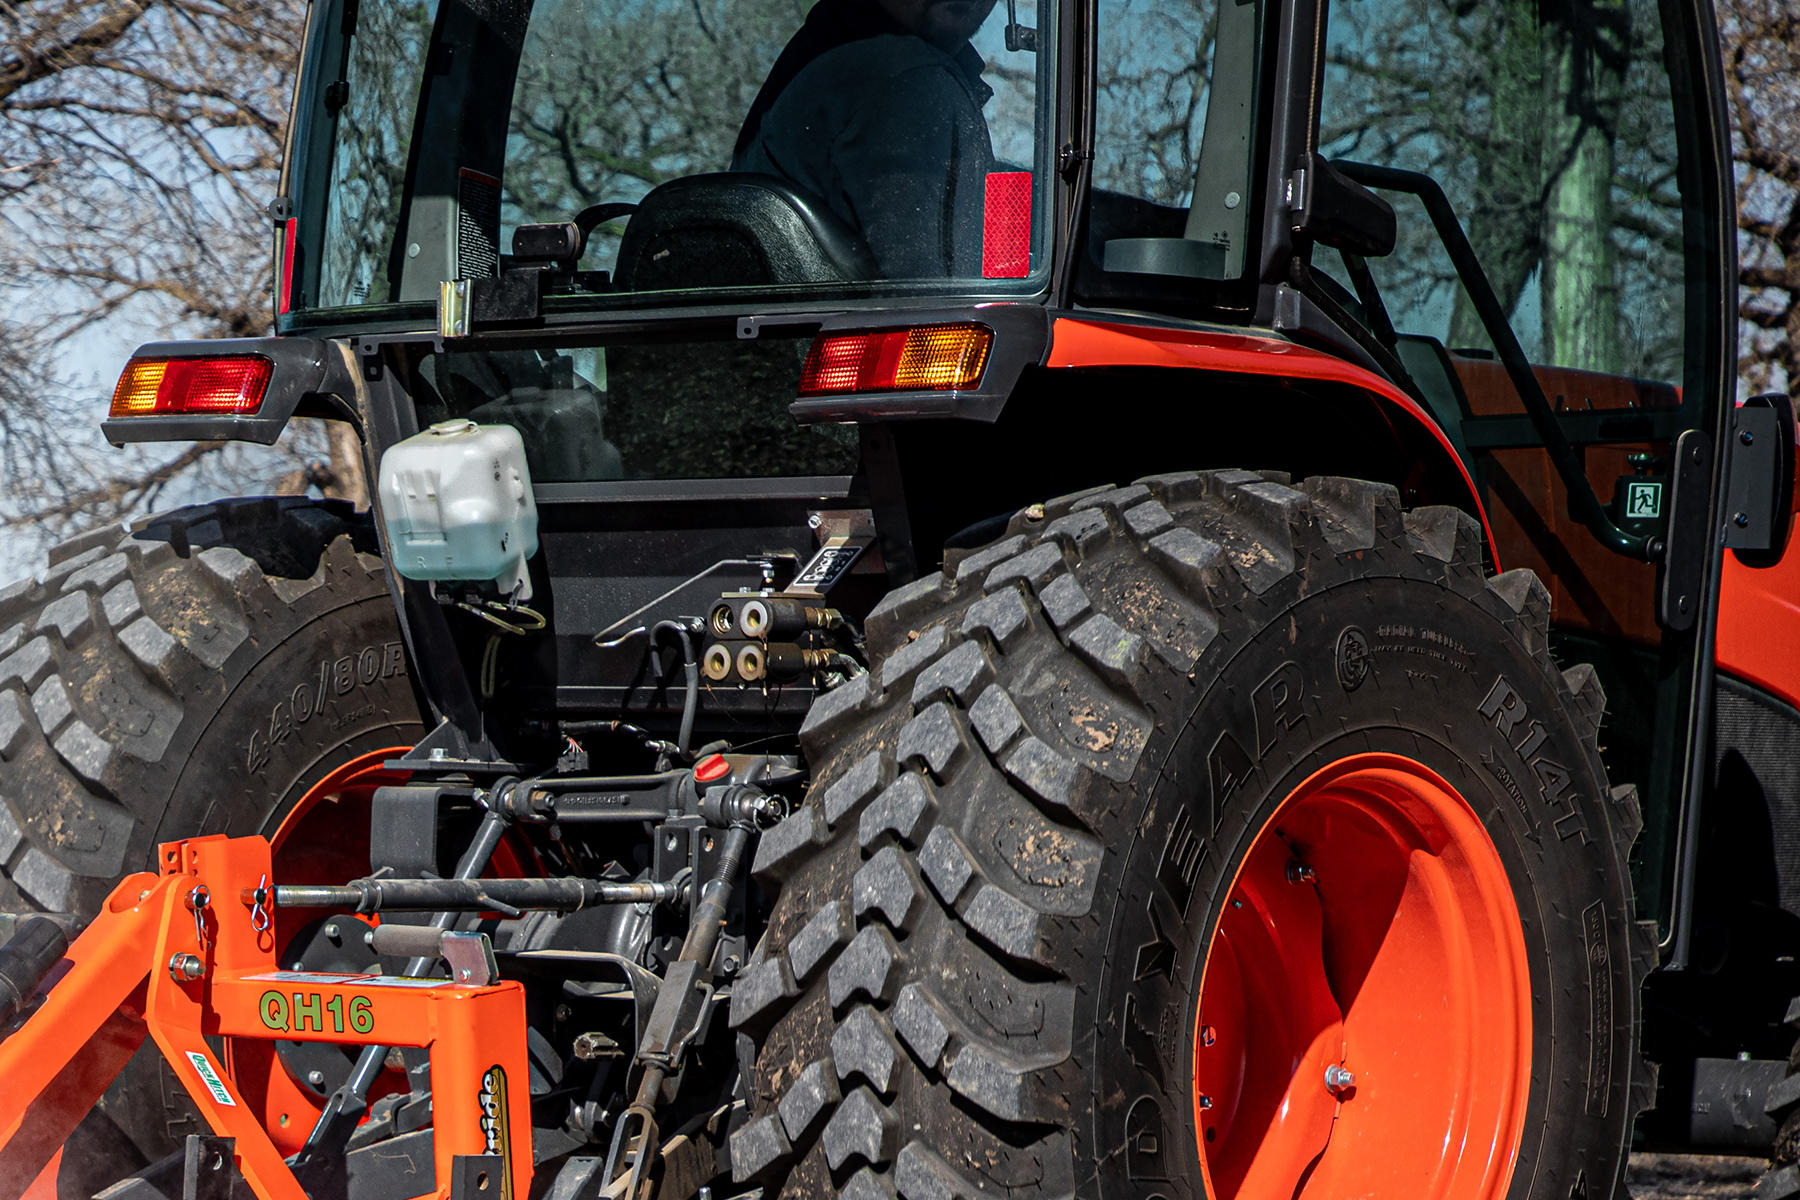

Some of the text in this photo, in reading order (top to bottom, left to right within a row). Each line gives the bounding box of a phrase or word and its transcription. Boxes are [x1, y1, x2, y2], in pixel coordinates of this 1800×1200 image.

[1476, 674, 1592, 846] R14T
[1497, 766, 1528, 814] ROTATION
[259, 990, 375, 1034] QH16
[480, 1072, 502, 1157] ride
